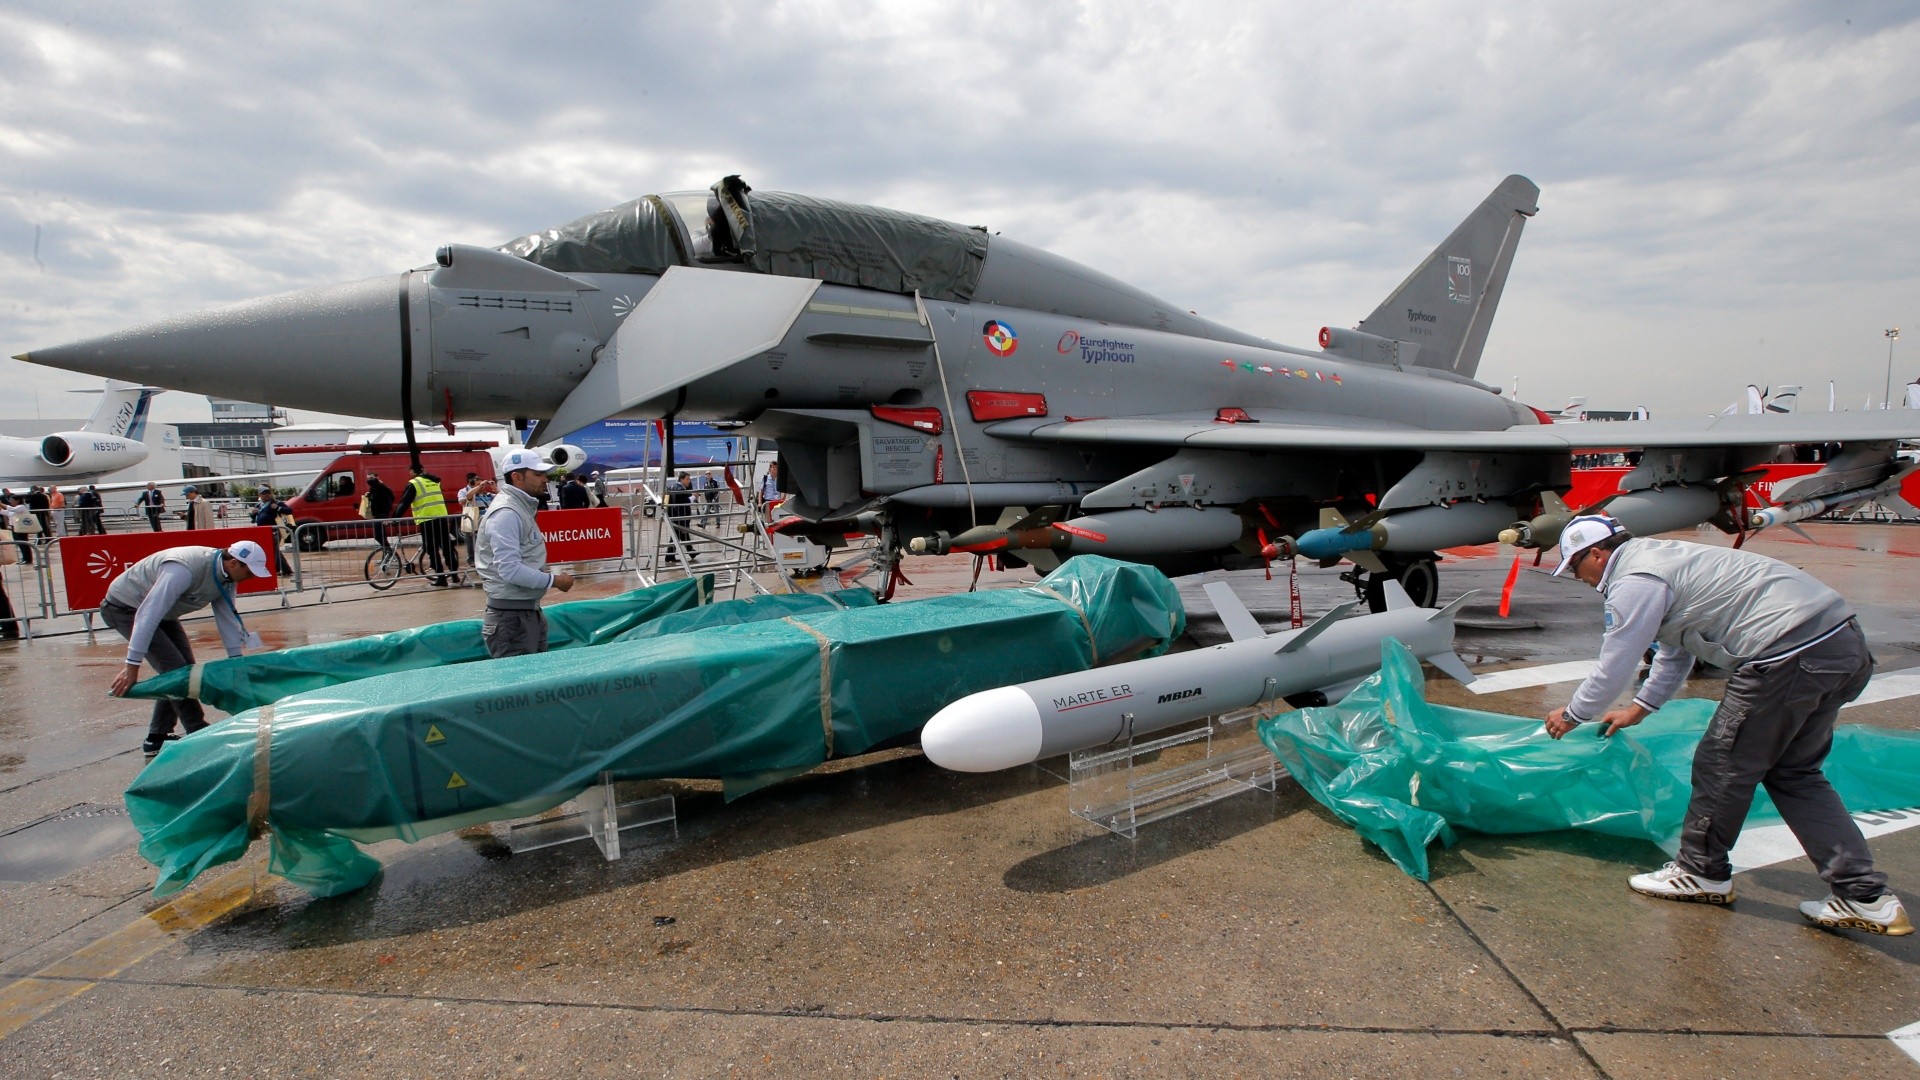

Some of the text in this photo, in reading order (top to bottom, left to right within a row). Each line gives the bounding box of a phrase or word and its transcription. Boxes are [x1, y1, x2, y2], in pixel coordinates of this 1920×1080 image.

[1457, 264, 1470, 276] 100
[1407, 309, 1436, 323] Typhoon
[1080, 337, 1134, 350] Eurofighter
[1080, 346, 1134, 364] Typhoon
[93, 442, 126, 452] N650PH
[541, 528, 611, 542] NMECCANICA
[475, 694, 530, 715] STORM
[535, 683, 599, 704] SHADOW
[614, 672, 658, 691] SCALP
[1053, 684, 1132, 709] MARTE ER
[1157, 687, 1202, 704] MBDA
